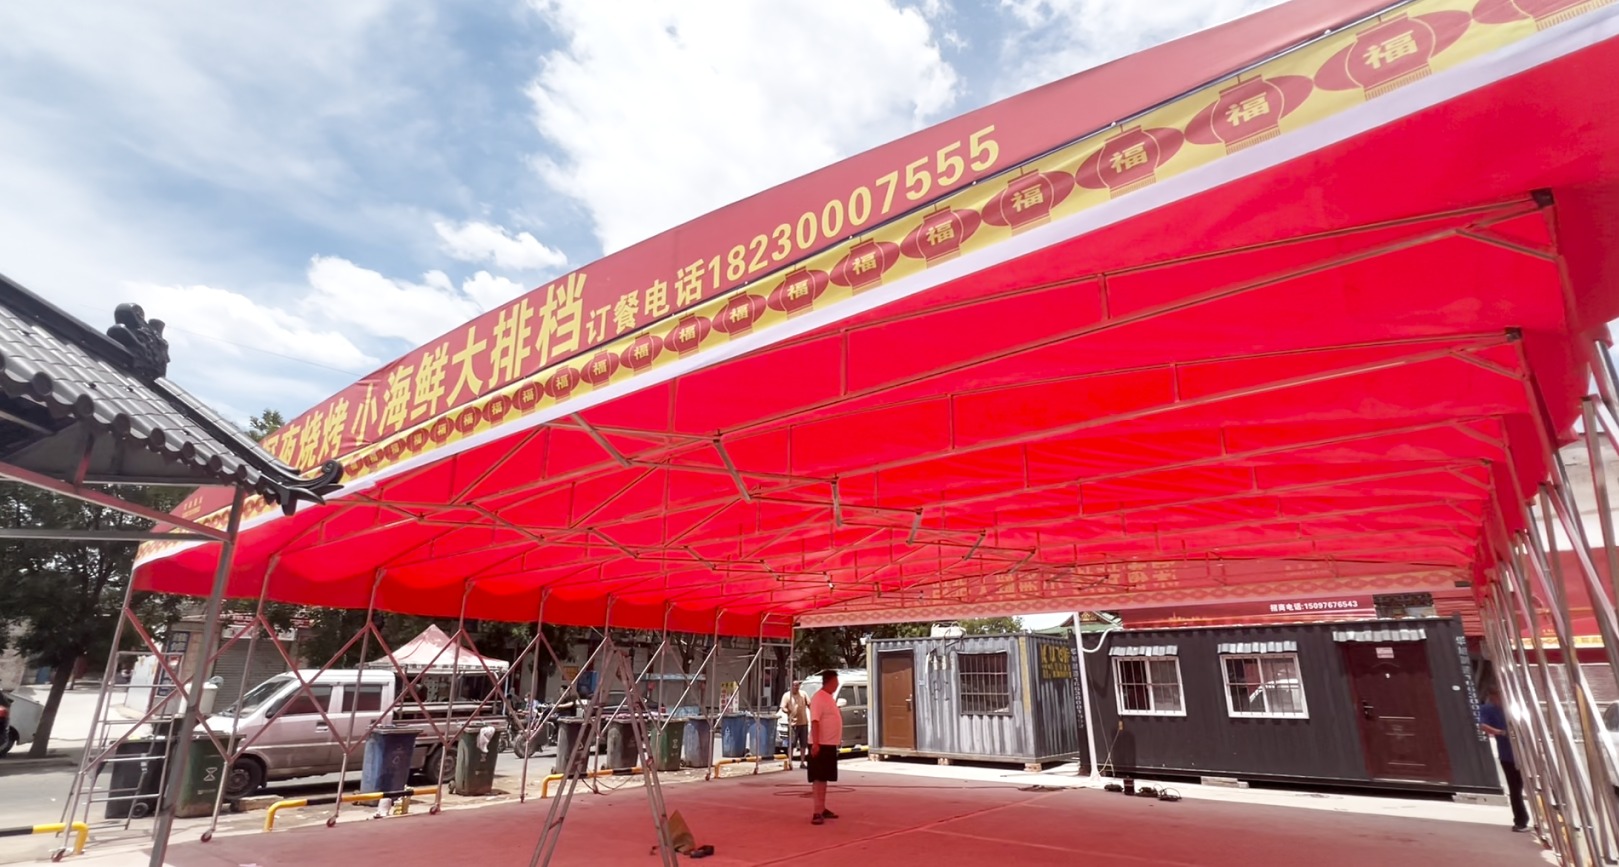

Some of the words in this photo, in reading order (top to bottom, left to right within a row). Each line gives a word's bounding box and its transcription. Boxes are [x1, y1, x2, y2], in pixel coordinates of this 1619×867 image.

[1363, 30, 1418, 69] 福
[1226, 92, 1270, 127] 福
[1110, 142, 1148, 173] 福
[1011, 185, 1043, 212] 福
[926, 219, 955, 246] 福
[852, 251, 878, 275] 福
[352, 272, 587, 446] 小海鲜大排档
[585, 124, 1000, 344] 订餐电话18230007555
[787, 278, 809, 301] 福
[729, 303, 749, 324] 福
[679, 325, 697, 344] 福
[633, 343, 650, 361] 福
[593, 359, 608, 375] 福
[555, 374, 570, 391] 福
[522, 387, 535, 403] 福
